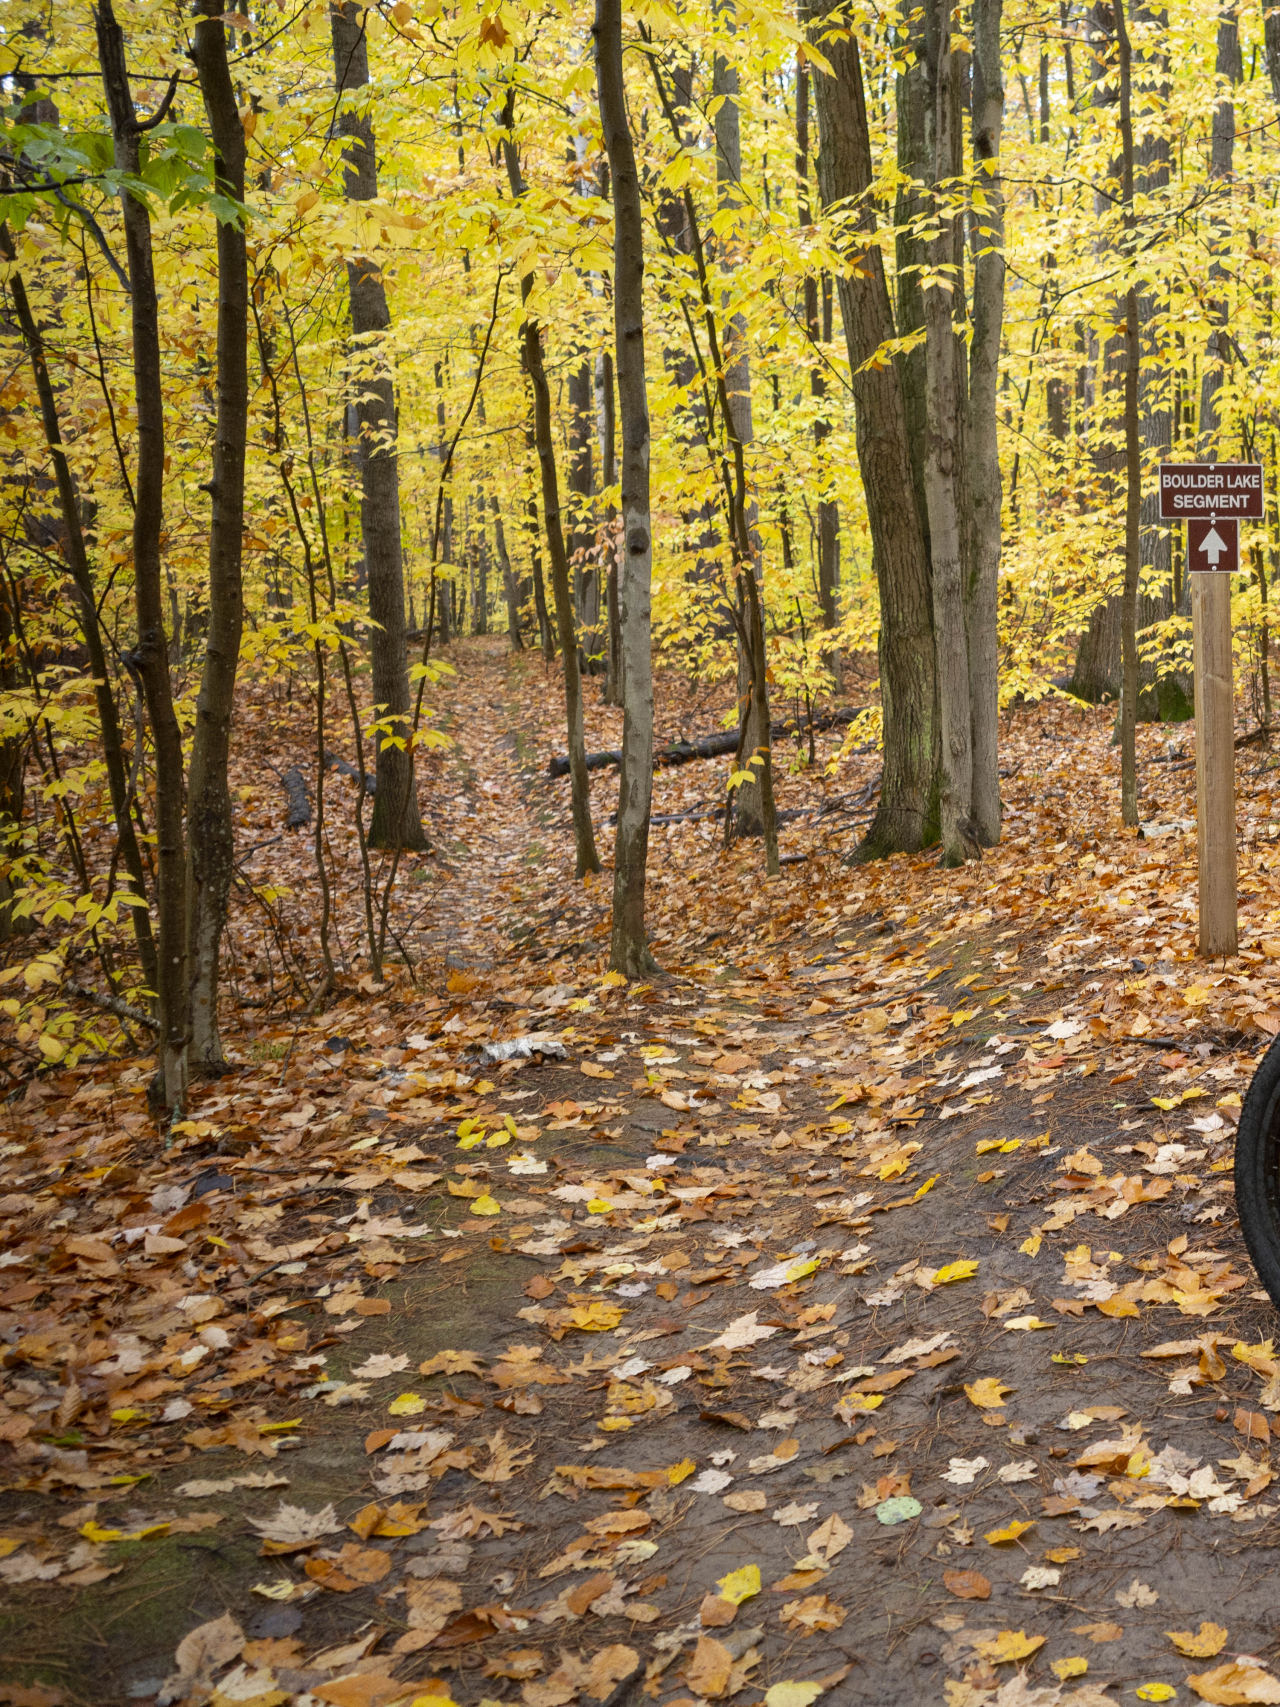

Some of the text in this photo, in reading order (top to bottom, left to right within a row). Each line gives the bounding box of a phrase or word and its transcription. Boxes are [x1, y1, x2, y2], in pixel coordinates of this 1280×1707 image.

[1162, 474, 1260, 488] BOULDER LAKE
[1173, 494, 1250, 509] SEGMENT
